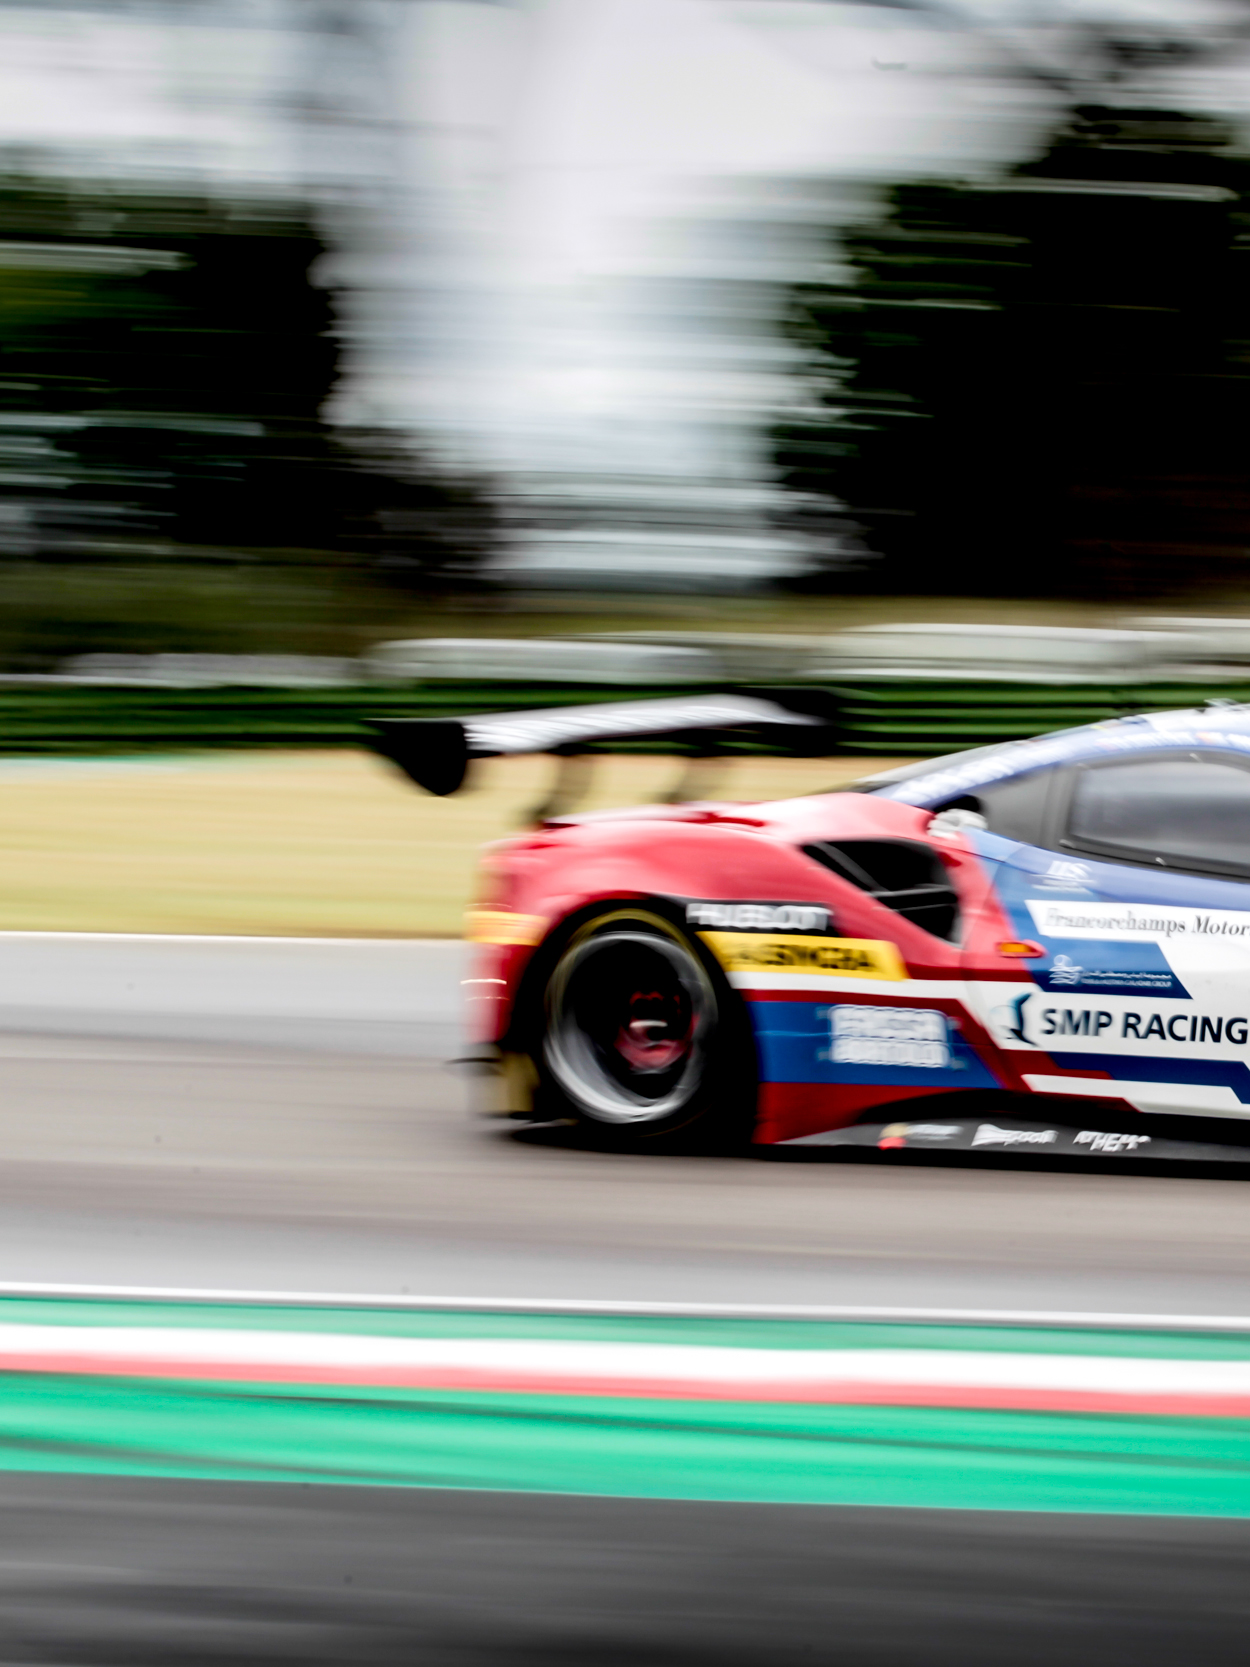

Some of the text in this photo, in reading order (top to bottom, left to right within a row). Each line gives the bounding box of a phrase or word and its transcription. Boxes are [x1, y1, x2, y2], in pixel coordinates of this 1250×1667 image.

[1046, 907, 1186, 937] Francorchamps
[1040, 1007, 1249, 1045] SMP RACING
